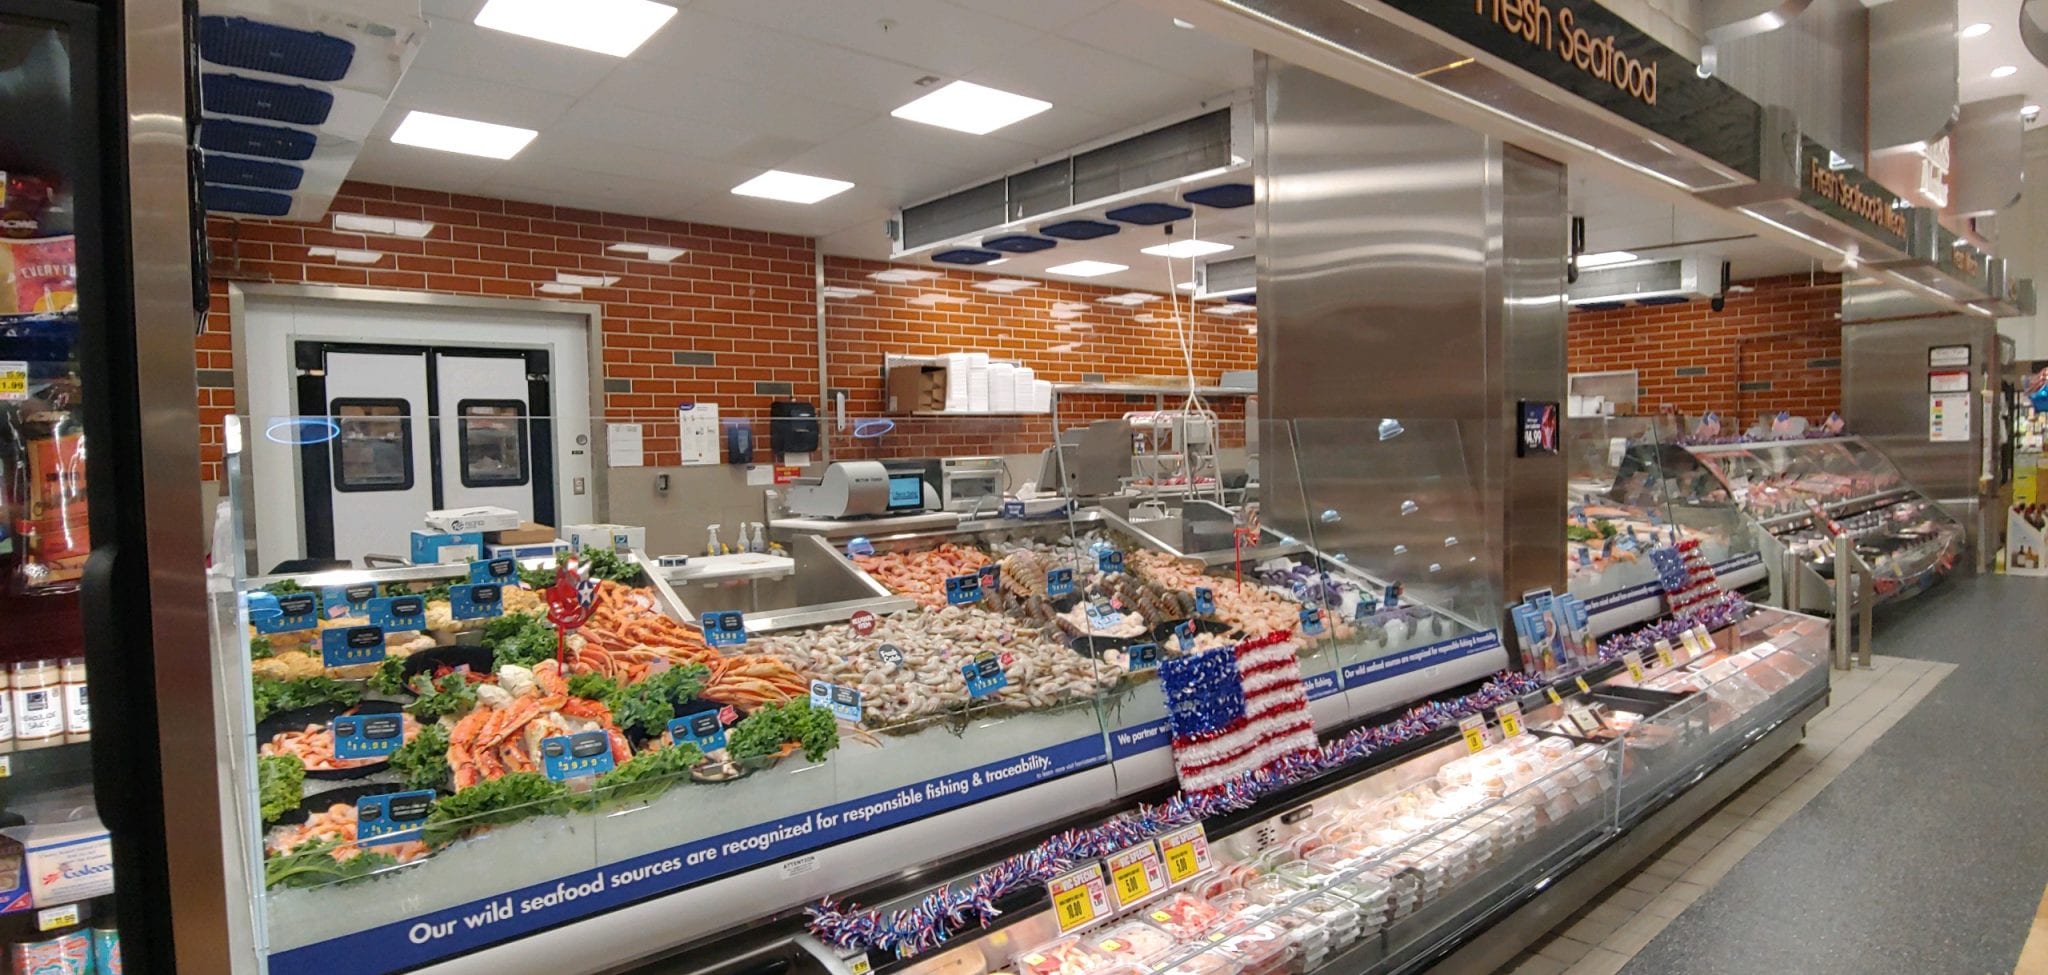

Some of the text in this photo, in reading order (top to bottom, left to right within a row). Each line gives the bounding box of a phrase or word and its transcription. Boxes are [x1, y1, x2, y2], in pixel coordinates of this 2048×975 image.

[1473, 0, 1657, 105] resh Seafood
[1344, 668, 1356, 679] Our
[1356, 664, 1366, 676] wild
[1366, 659, 1385, 673] seafood
[1409, 647, 1431, 661] recognized
[1438, 641, 1459, 654] responsible
[1460, 638, 1472, 648] fishing
[1117, 733, 1131, 745] We
[1132, 727, 1158, 744] partner
[408, 754, 1052, 944] Our wild seafood sources are recognized for responsible fishing & traceability.
[1125, 875, 1139, 893] 5.00
[1066, 900, 1083, 919] 10.00
